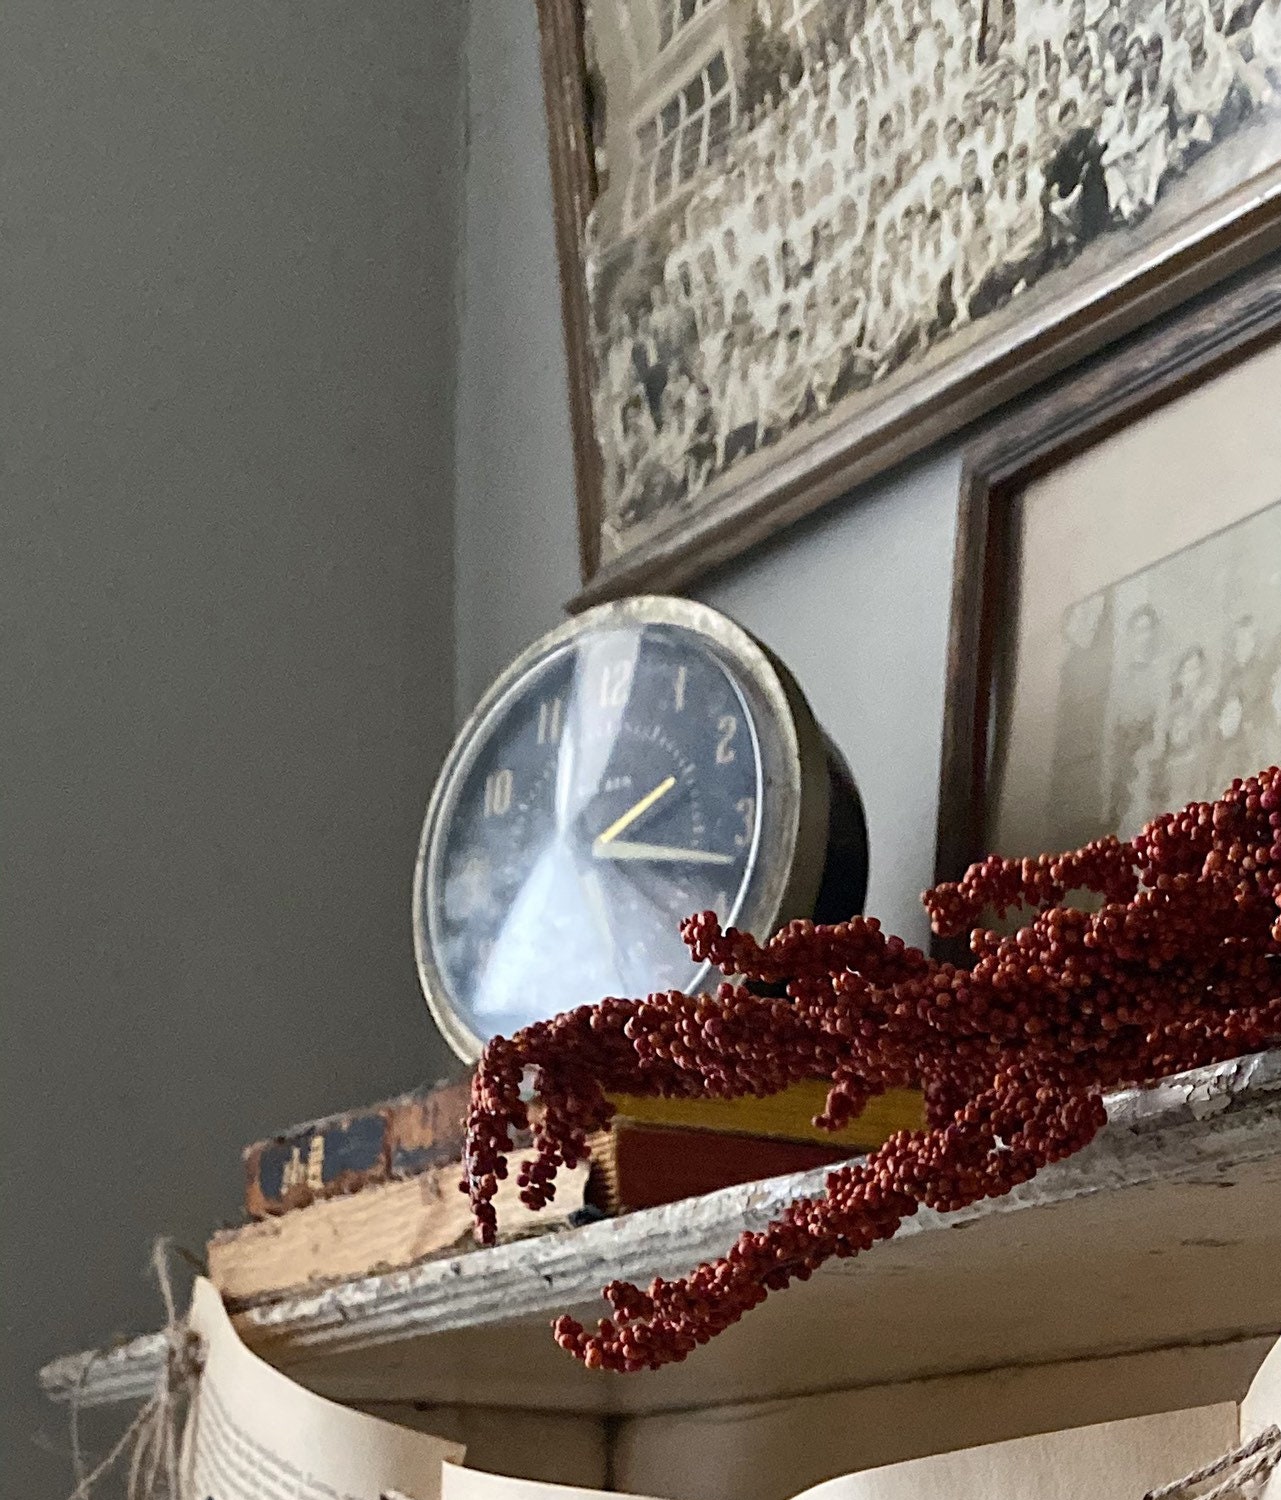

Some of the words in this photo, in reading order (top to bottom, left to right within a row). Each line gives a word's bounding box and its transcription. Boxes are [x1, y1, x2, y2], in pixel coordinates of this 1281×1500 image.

[674, 666, 688, 714] 1
[715, 714, 738, 765] 2
[484, 767, 514, 818] 10
